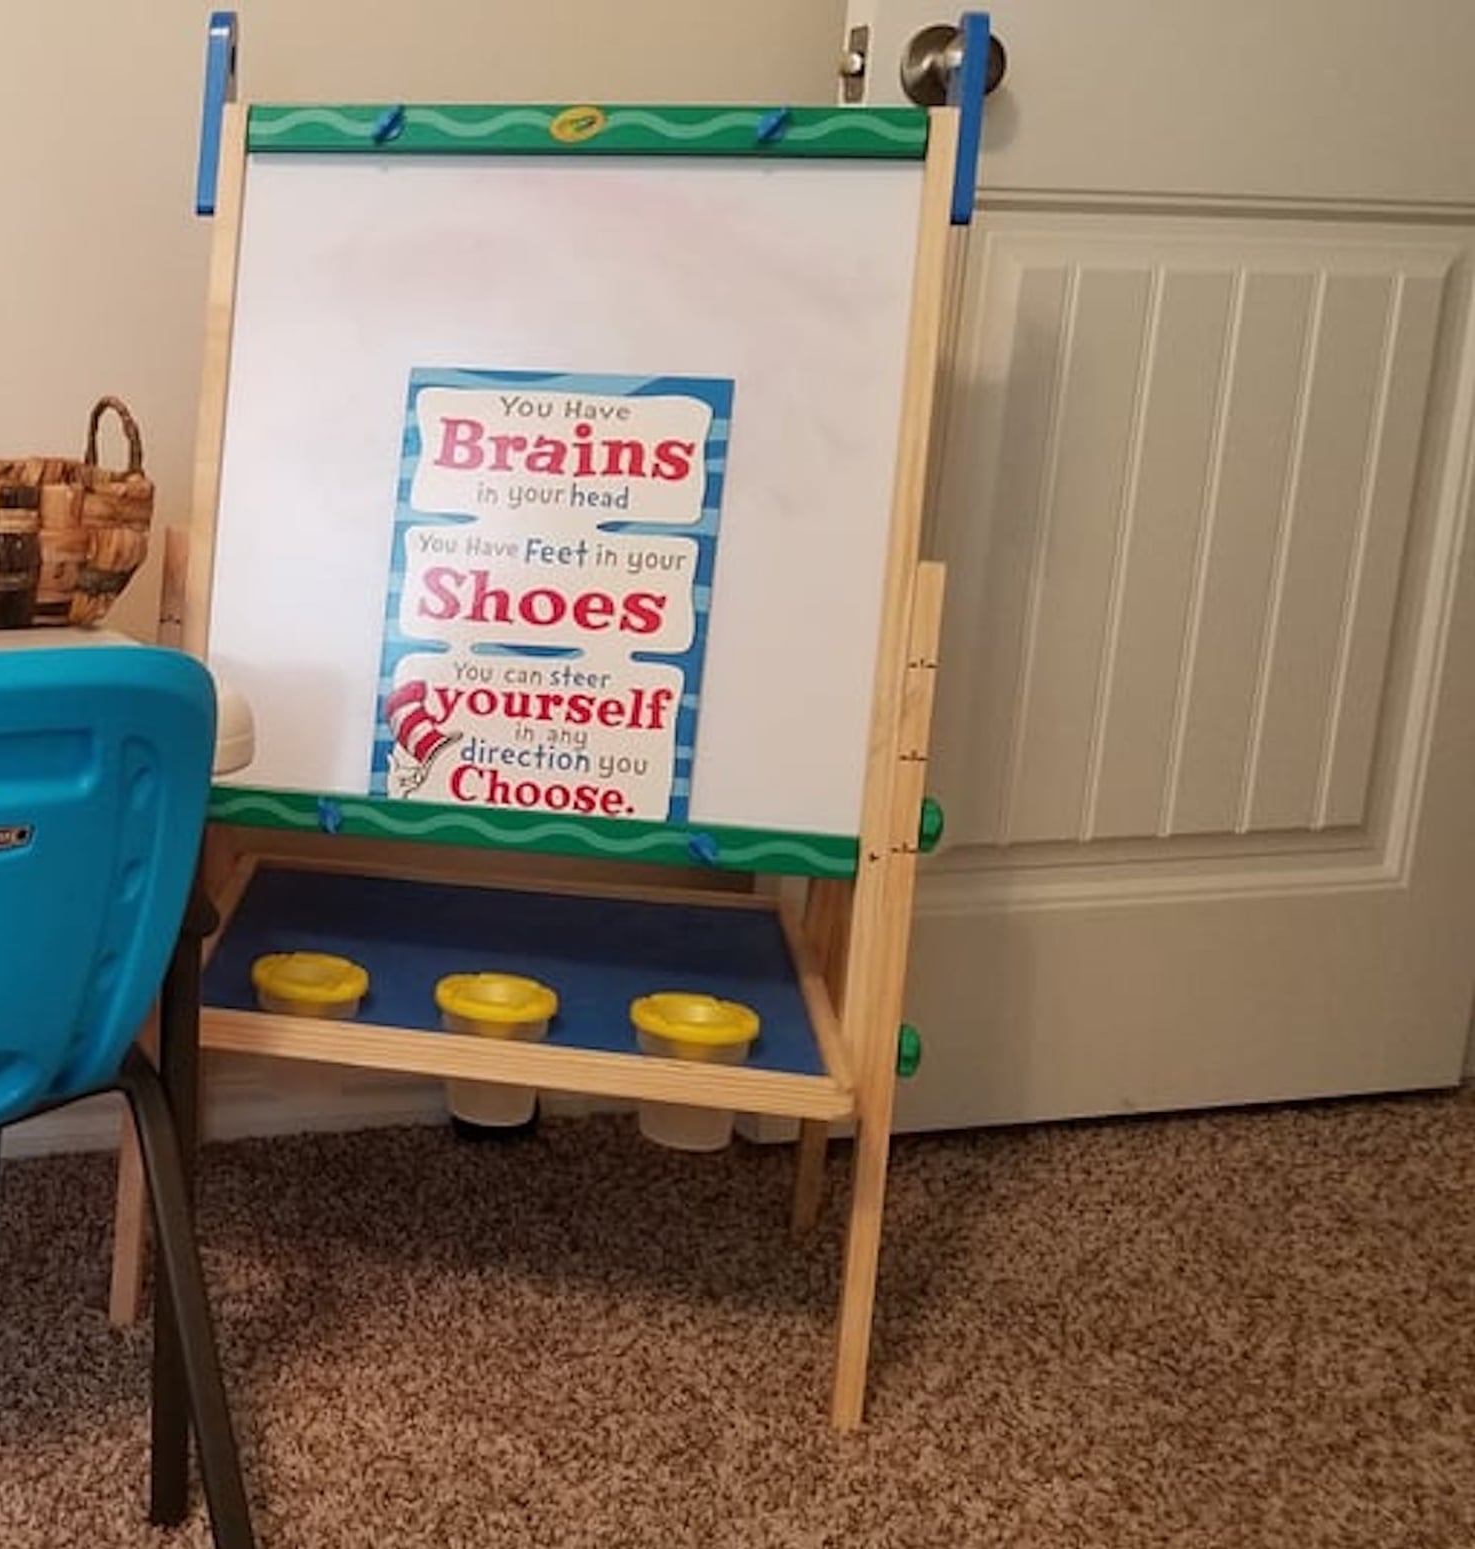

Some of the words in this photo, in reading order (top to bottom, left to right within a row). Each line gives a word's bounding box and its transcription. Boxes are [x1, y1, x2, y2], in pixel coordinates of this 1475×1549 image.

[500, 396, 553, 418] You
[564, 400, 631, 420] Have
[434, 417, 695, 480] Brains
[477, 482, 498, 504] in
[509, 485, 564, 509] your
[570, 483, 629, 508] head
[419, 534, 457, 553] You
[465, 536, 519, 557] Have
[524, 539, 588, 568] Feet
[595, 544, 618, 566] in
[627, 551, 686, 574] your
[418, 567, 666, 634] Shoes
[455, 661, 493, 681] You
[503, 668, 543, 686] can
[550, 665, 611, 688] steer
[431, 687, 674, 730] yourself
[460, 734, 590, 773] direction
[599, 752, 648, 778] you
[515, 722, 535, 742] in
[547, 727, 588, 750] any
[450, 764, 635, 814] Choose.
